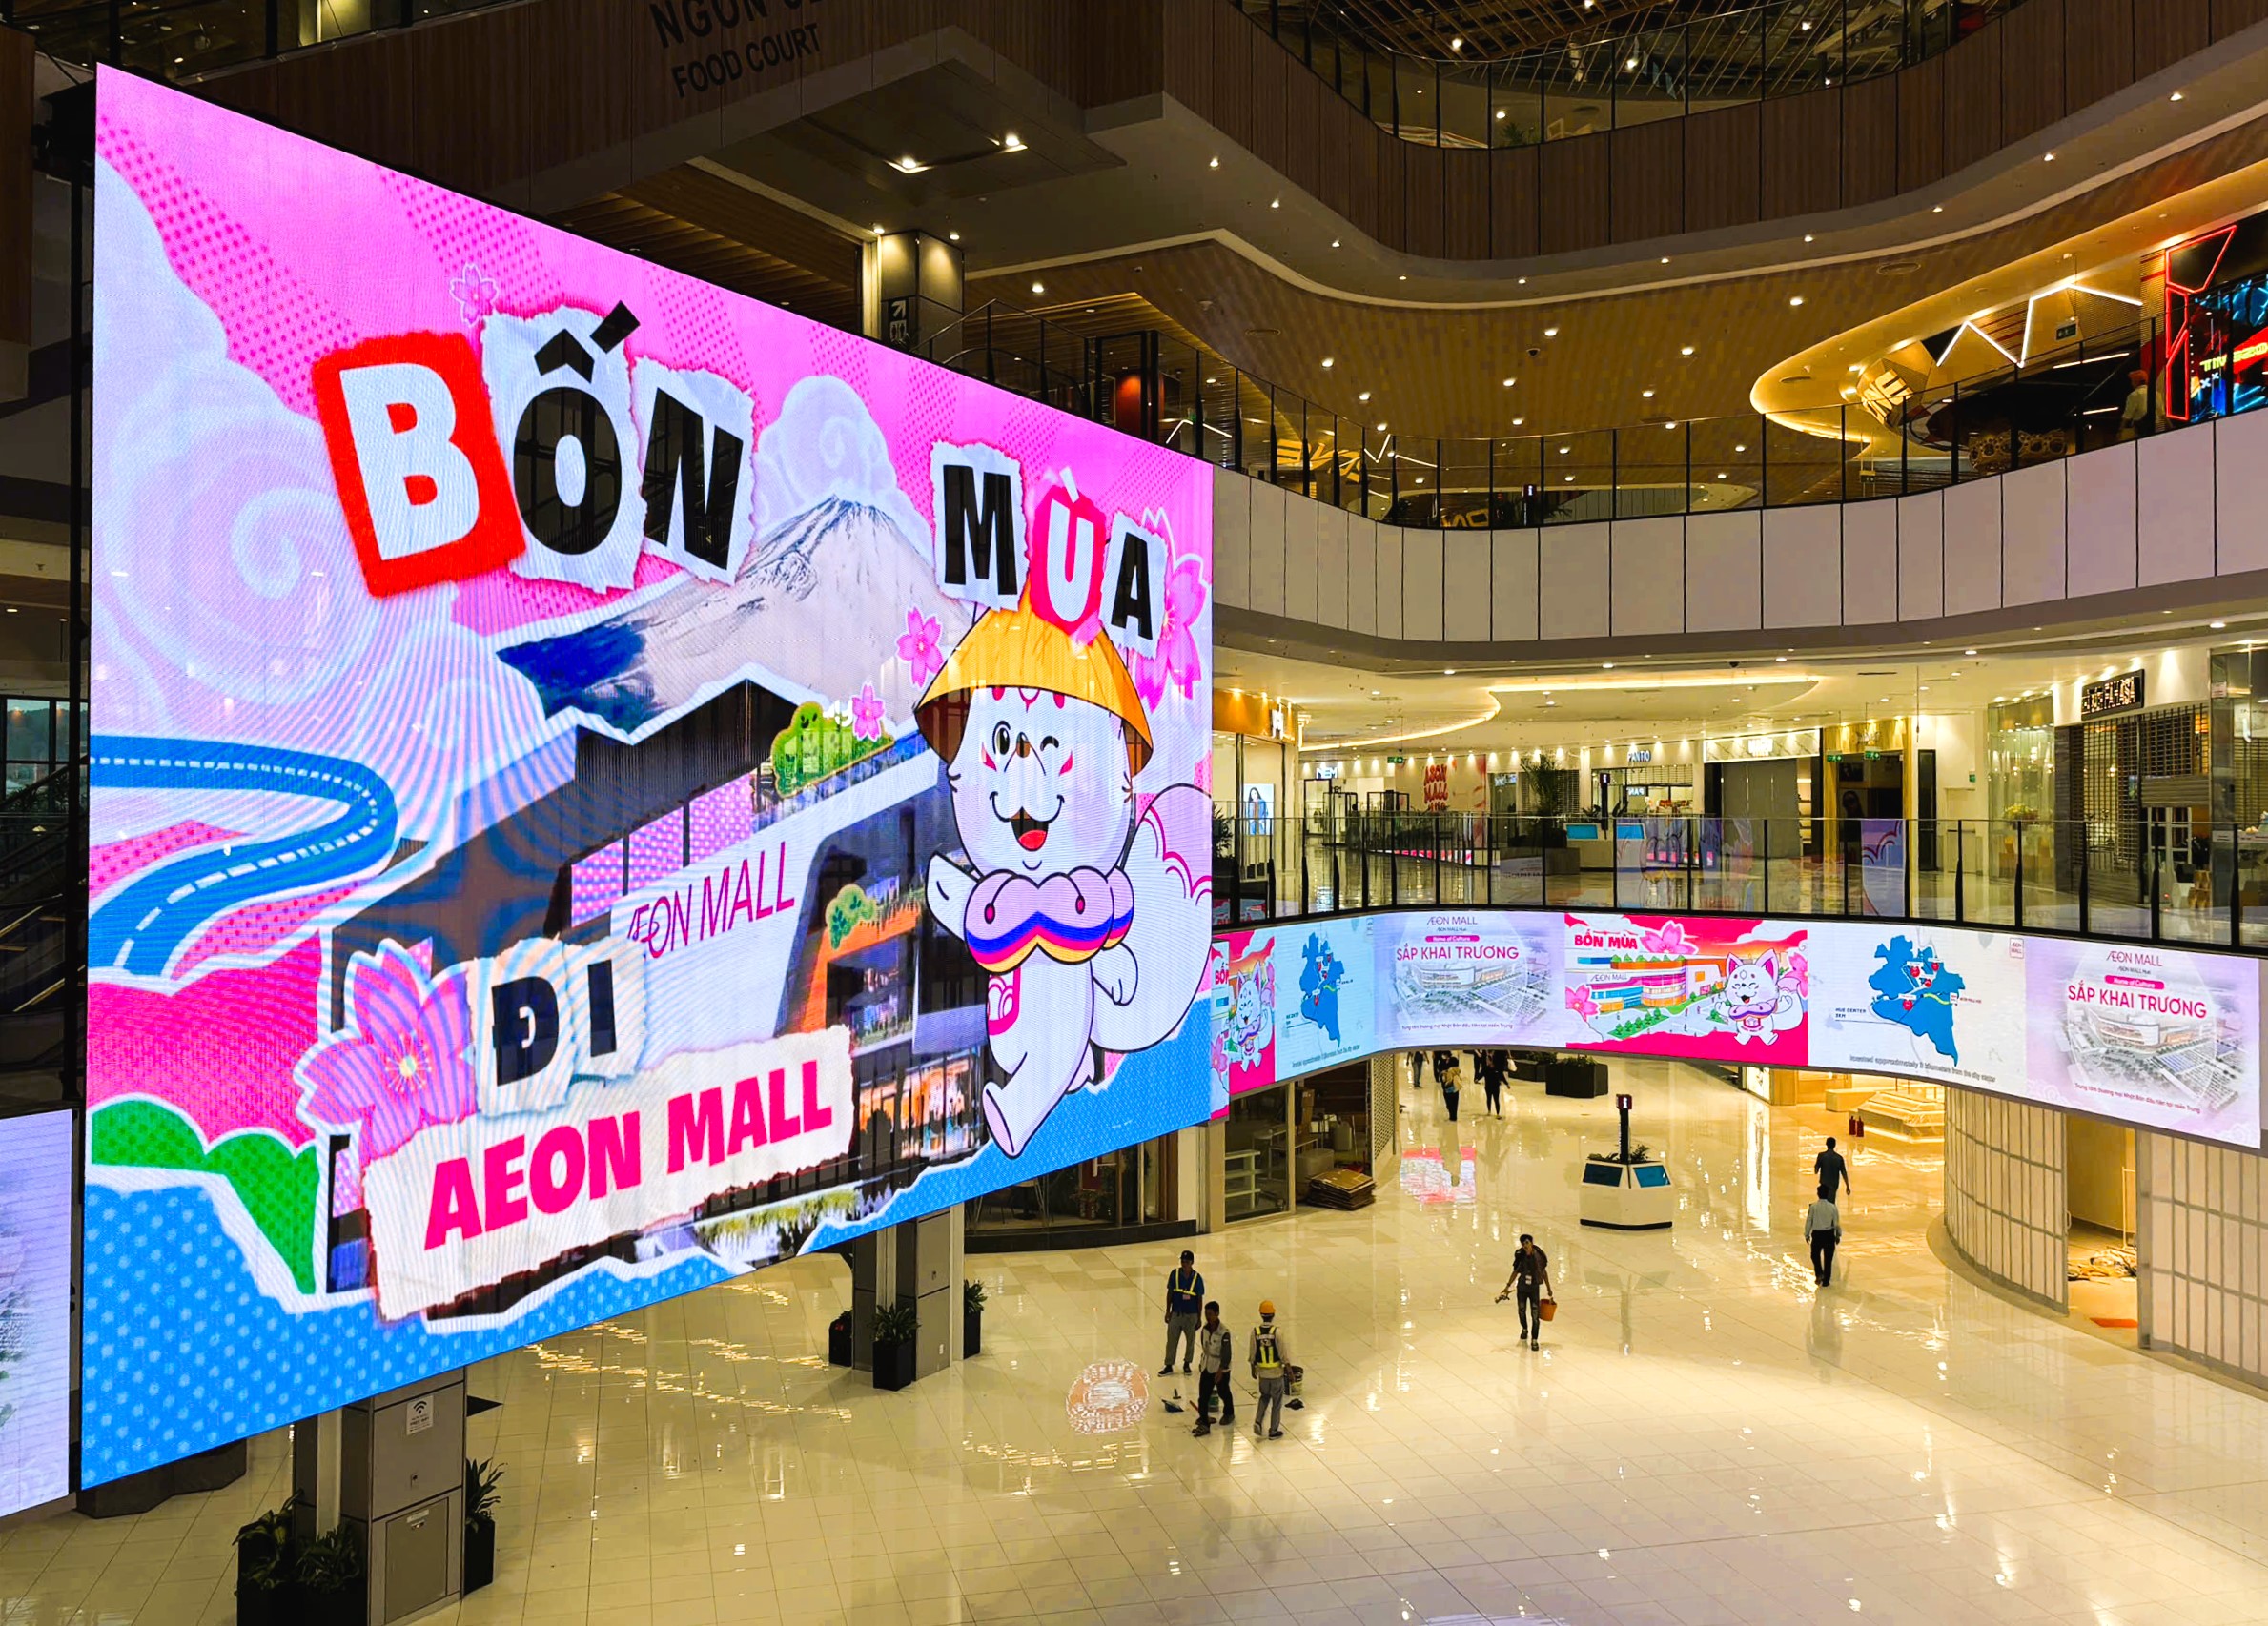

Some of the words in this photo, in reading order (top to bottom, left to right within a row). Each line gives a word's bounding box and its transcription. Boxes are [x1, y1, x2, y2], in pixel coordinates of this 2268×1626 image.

[671, 49, 743, 98] FOOD
[746, 23, 821, 72] COURT
[339, 300, 744, 570] BỐN
[942, 466, 1154, 640] MÙA
[699, 841, 795, 942] MALL
[1451, 916, 1479, 925] MALL
[1574, 928, 1604, 948] BỐN
[1608, 933, 1638, 950] MÙA
[1420, 946, 1451, 960] KHAI
[1455, 945, 1520, 960] TRƯƠNG
[2135, 953, 2164, 967] MALL
[490, 959, 618, 1087] ĐI
[2099, 988, 2135, 1009] KHAI
[2138, 993, 2208, 1019] TRƯƠNG
[424, 1110, 643, 1251] AEON
[666, 1059, 832, 1175] MALL
